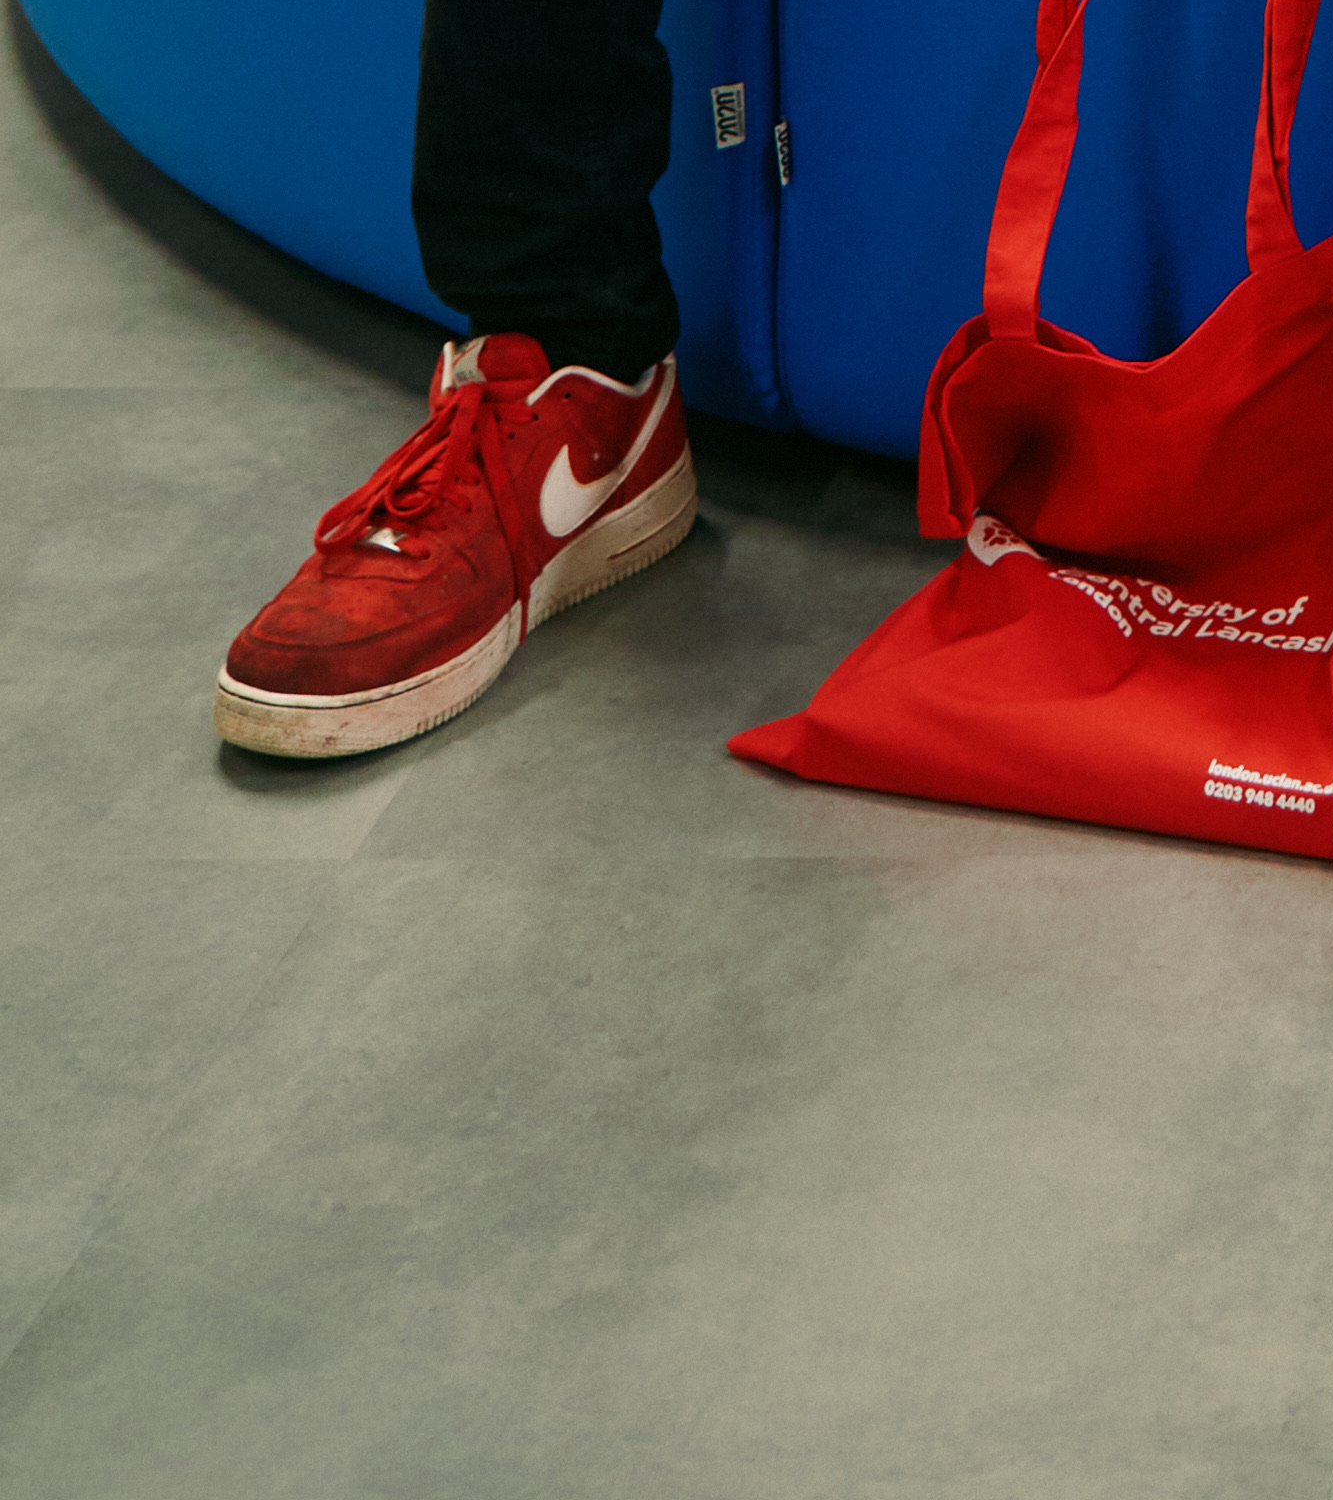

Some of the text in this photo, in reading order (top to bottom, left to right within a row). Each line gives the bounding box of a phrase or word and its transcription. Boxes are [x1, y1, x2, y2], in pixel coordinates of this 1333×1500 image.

[1136, 579, 1309, 625] ersity of
[1204, 779, 1315, 814] 0203 948 4440
